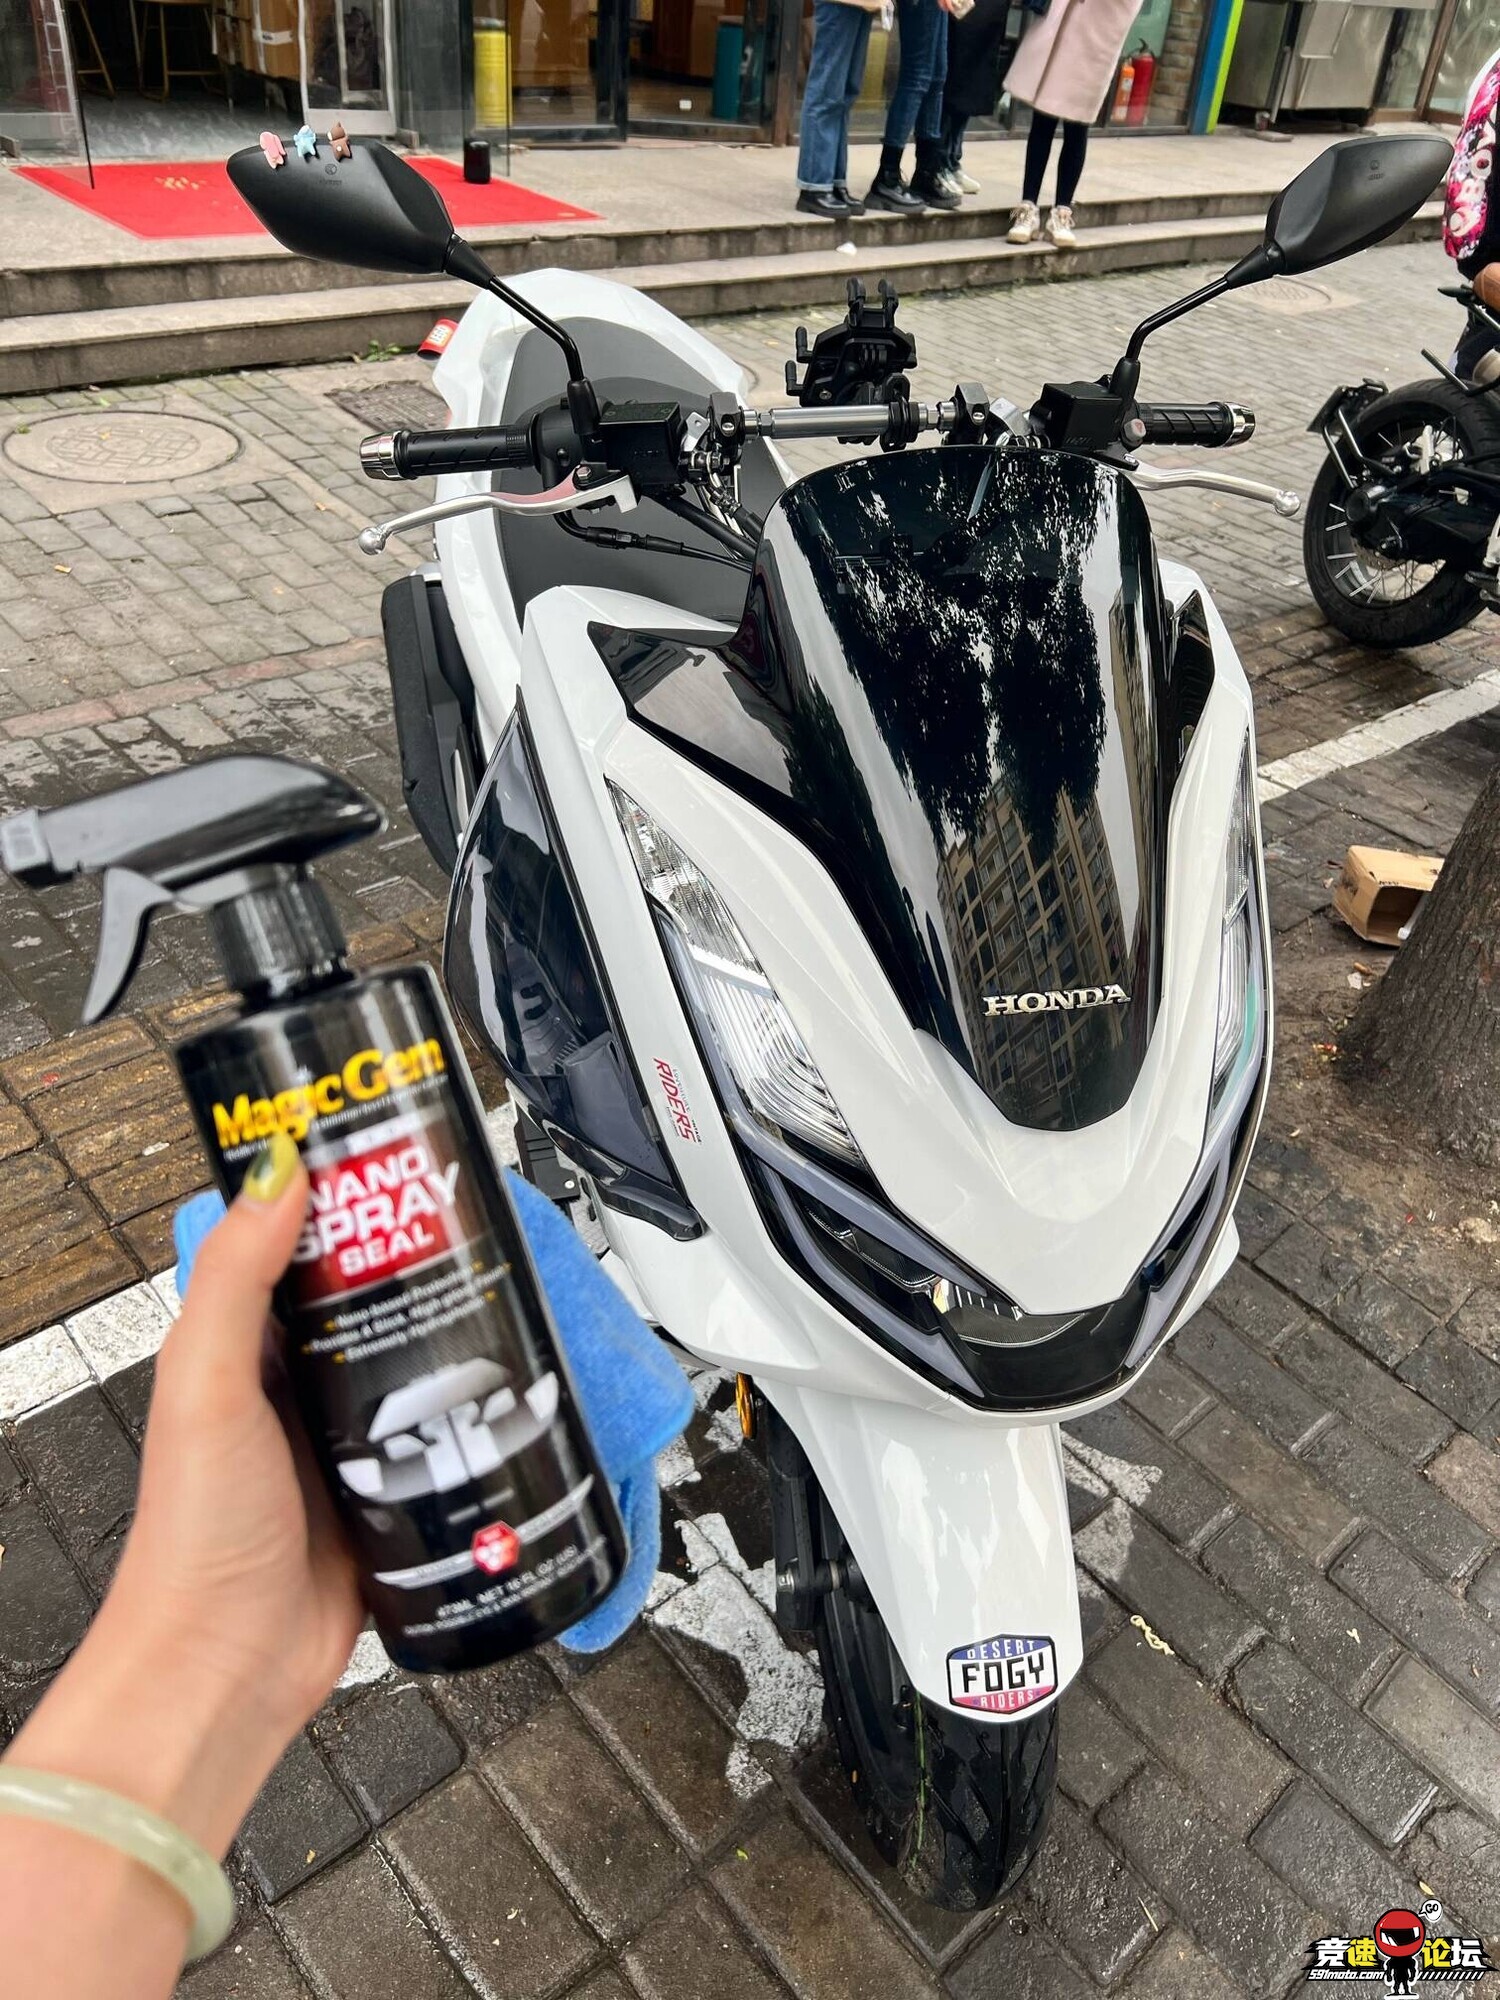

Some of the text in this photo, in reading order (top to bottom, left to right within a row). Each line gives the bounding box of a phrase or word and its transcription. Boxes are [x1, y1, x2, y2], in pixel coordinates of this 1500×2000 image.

[983, 983, 1132, 1016] HONDA
[652, 1057, 697, 1143] RIDERS
[308, 1146, 429, 1215] NANO
[292, 1161, 460, 1263] SPRAY
[338, 1221, 435, 1277] SEAL
[962, 1651, 1045, 1693] FOGY
[967, 1638, 1035, 1660] DESERT
[979, 1690, 1034, 1709] RIDERS
